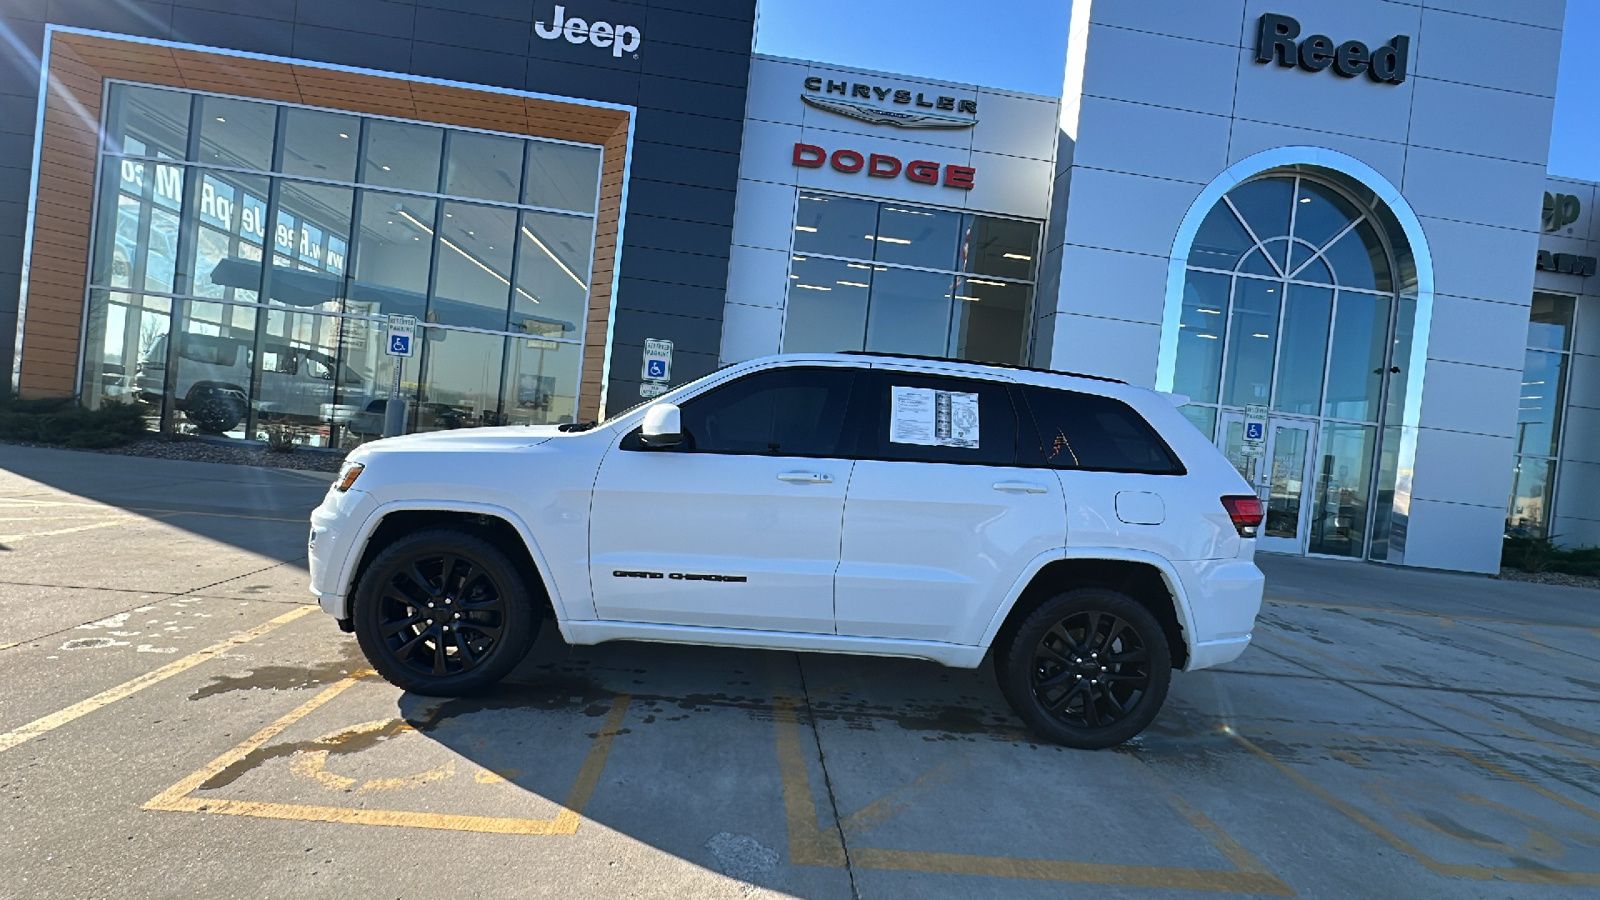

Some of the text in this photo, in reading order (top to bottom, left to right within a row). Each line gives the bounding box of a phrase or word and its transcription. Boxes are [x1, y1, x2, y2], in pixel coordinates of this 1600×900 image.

[535, 5, 640, 57] Jeep
[1255, 12, 1410, 85] Reed
[804, 76, 977, 113] CHRYSLER
[792, 142, 976, 190] DODGE
[1537, 249, 1597, 276] AM
